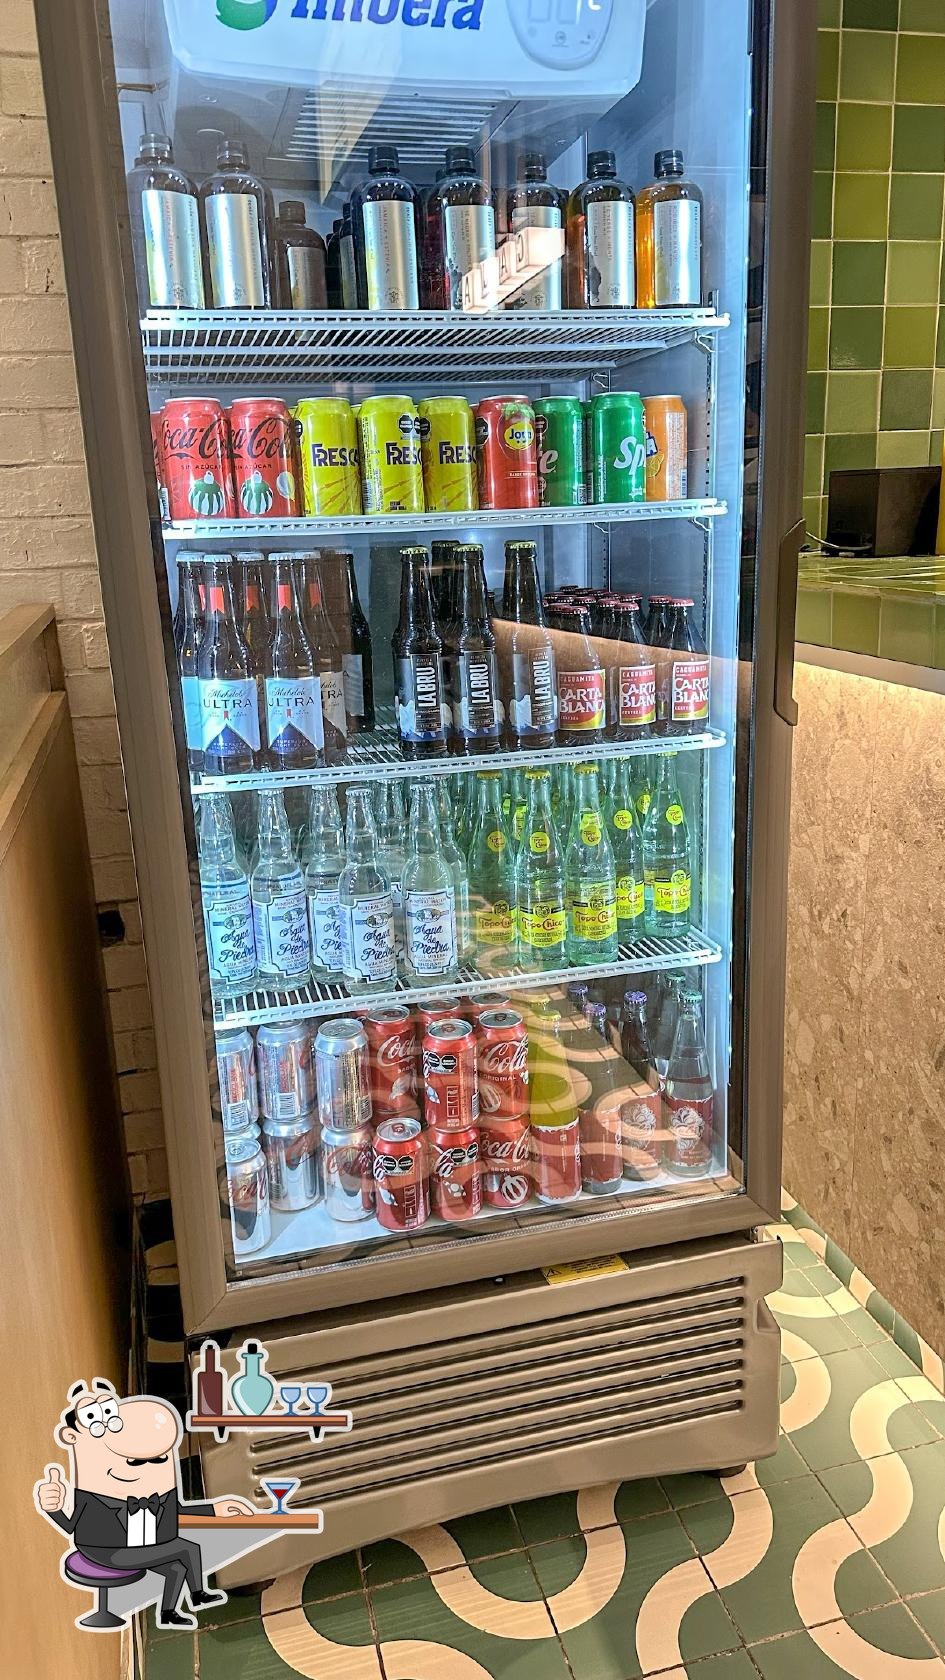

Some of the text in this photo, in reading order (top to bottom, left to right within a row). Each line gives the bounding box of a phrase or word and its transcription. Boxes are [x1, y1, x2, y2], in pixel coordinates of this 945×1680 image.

[560, 687, 602, 702] CARTA
[203, 698, 253, 709] ULTRA
[542, 918, 563, 931] Chico
[413, 924, 444, 940] Agua
[410, 940, 450, 954] Piedra
